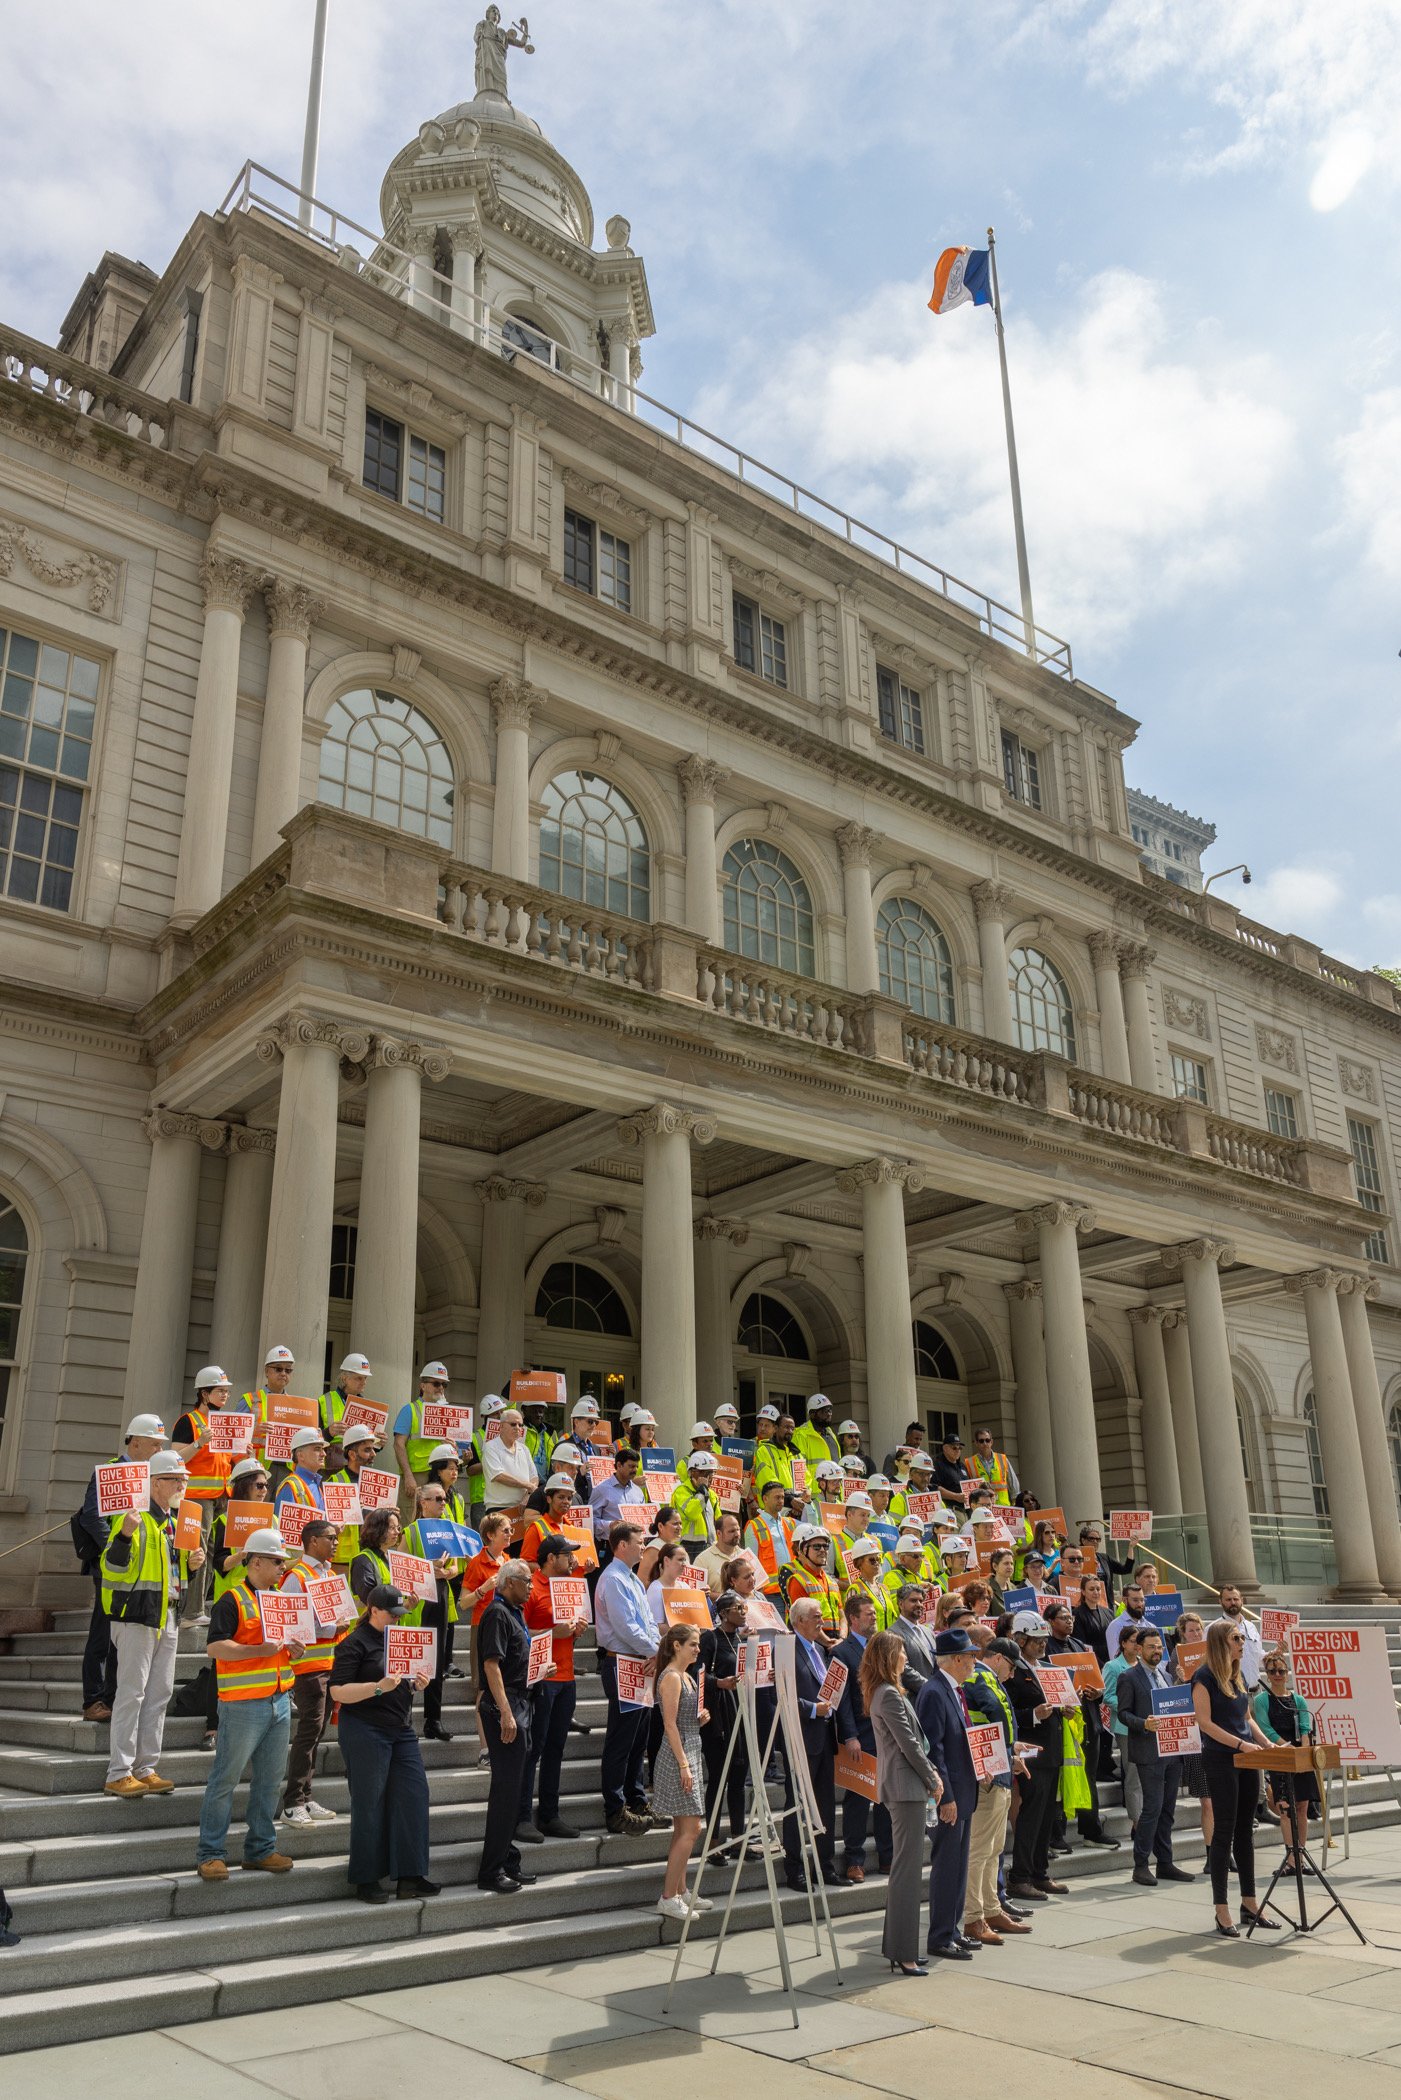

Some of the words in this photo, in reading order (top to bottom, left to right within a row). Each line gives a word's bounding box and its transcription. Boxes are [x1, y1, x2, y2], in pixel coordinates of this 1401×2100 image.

[274, 1406, 313, 1417] BUILDBETTER
[350, 1406, 364, 1417] GIVE
[365, 1410, 373, 1420] US
[374, 1413, 386, 1424] THE
[425, 1407, 442, 1416] GIVE
[443, 1407, 454, 1417] US
[455, 1409, 468, 1418] THE
[211, 1416, 227, 1426] GIVE
[229, 1416, 239, 1426] US
[241, 1417, 252, 1427] THE
[424, 1418, 448, 1427] TOOLS
[449, 1419, 459, 1427] WE
[235, 1428, 245, 1437] WE
[424, 1427, 446, 1437] NEED.
[211, 1439, 232, 1449] NEED.
[270, 1438, 291, 1447] TOOLS
[268, 1449, 290, 1458] NEED.
[100, 1468, 123, 1481] GIVE
[125, 1467, 136, 1479] US
[136, 1466, 147, 1477] THE
[362, 1471, 376, 1482] GIVE
[377, 1474, 385, 1484] US
[386, 1477, 397, 1487] THE
[102, 1483, 131, 1496] TOOLS
[132, 1481, 142, 1492] WE
[325, 1486, 337, 1496] GIVE
[338, 1487, 344, 1496] US
[345, 1487, 356, 1497] THE
[361, 1484, 379, 1494] TOOLS
[380, 1488, 388, 1498] WE
[102, 1497, 132, 1511] NEED.
[327, 1499, 342, 1508] TOOLS
[343, 1499, 350, 1508] WE
[922, 1495, 929, 1503] US
[282, 1506, 300, 1518] GIVE
[301, 1510, 311, 1520] US
[569, 1509, 577, 1517] US
[578, 1508, 589, 1517] THE
[910, 1505, 927, 1513] TOOLS
[234, 1516, 269, 1525] BUILDBETTER
[1137, 1513, 1148, 1521] THE
[183, 1525, 196, 1533] NYC
[281, 1520, 303, 1531] TOOLS
[391, 1555, 407, 1566] GIVE
[408, 1559, 417, 1569] US
[418, 1561, 430, 1572] THE
[392, 1568, 413, 1580] TOOLS
[414, 1572, 424, 1583] WE
[685, 1568, 692, 1577] US
[693, 1570, 704, 1579] THE
[309, 1584, 323, 1596] GIVE
[324, 1582, 333, 1592] US
[333, 1580, 344, 1590] THE
[553, 1582, 567, 1592] GIVE
[568, 1582, 576, 1592] US
[576, 1582, 586, 1592] THE
[263, 1596, 277, 1608] GIVE
[278, 1597, 288, 1608] US
[290, 1598, 307, 1609] THE
[314, 1596, 331, 1608] TOOLS
[332, 1594, 341, 1604] WE
[554, 1595, 573, 1605] TOOLS
[573, 1595, 582, 1605] WE
[1145, 1604, 1177, 1612] BUILDFASTER
[264, 1611, 283, 1623] TOOLS
[284, 1612, 297, 1624] WE
[1263, 1611, 1278, 1620] GIVE
[1279, 1613, 1287, 1622] US
[1288, 1614, 1297, 1623] THE
[1263, 1622, 1283, 1631] TOOLS
[390, 1632, 405, 1643] GIVE
[407, 1632, 417, 1643] US
[417, 1632, 432, 1644] THE
[1291, 1632, 1358, 1651] DESIGN,
[390, 1646, 410, 1658] TOOLS
[411, 1647, 422, 1658] WE
[389, 1662, 409, 1674] NEED.
[633, 1663, 640, 1673] US
[1296, 1655, 1331, 1674] AND
[636, 1676, 644, 1688] WE
[1298, 1679, 1347, 1698] BUILD
[1159, 1698, 1190, 1709] BUILDFASTER
[1173, 1716, 1182, 1727] US
[1183, 1715, 1194, 1726] THE
[984, 1728, 998, 1741] THE
[1159, 1729, 1178, 1740] TOOLS
[1178, 1728, 1187, 1739] WE
[982, 1744, 992, 1758] WE
[1160, 1741, 1178, 1752] NEED.
